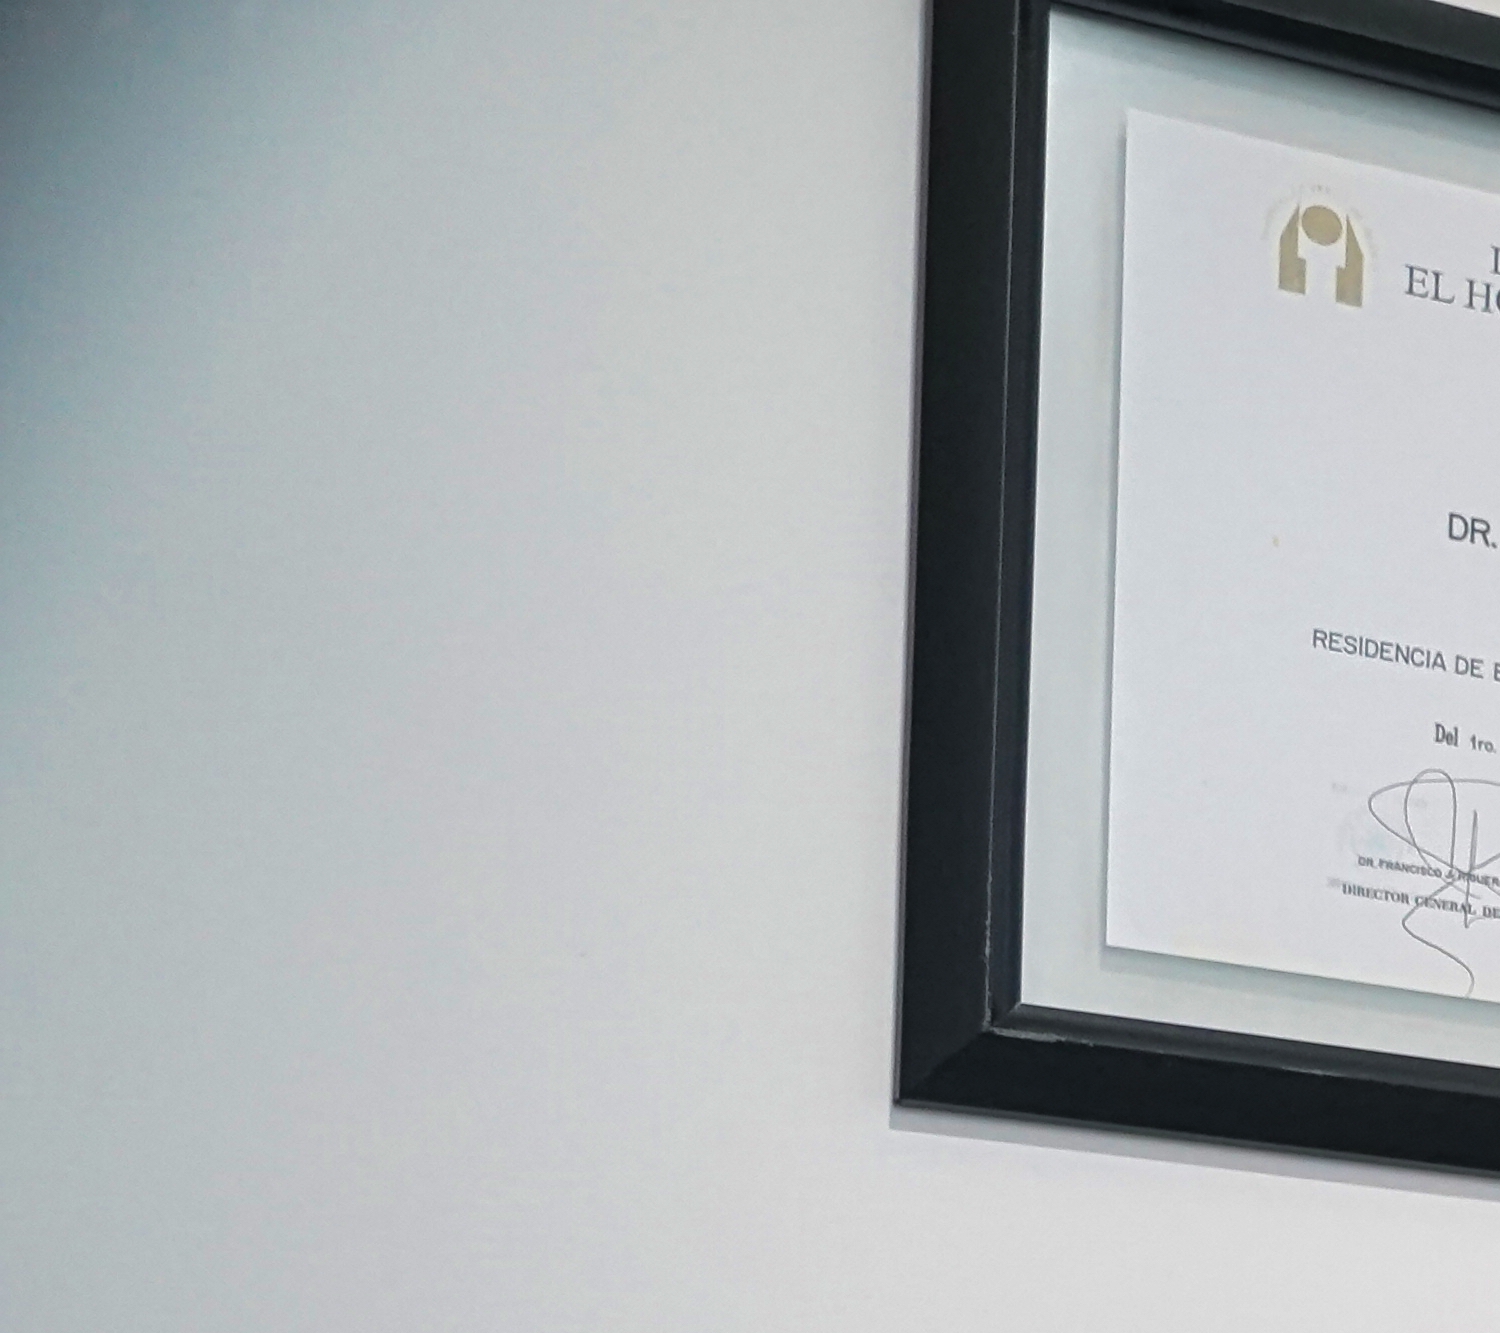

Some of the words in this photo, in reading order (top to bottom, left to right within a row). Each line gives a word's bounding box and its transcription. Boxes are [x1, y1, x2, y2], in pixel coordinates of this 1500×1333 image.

[1404, 264, 1455, 307] EL
[1448, 512, 1498, 550] DR.
[1312, 628, 1446, 672] RESIDENCIA
[1455, 653, 1484, 678] DE
[1434, 722, 1457, 747] Del
[1342, 883, 1409, 905] DIRECTOR
